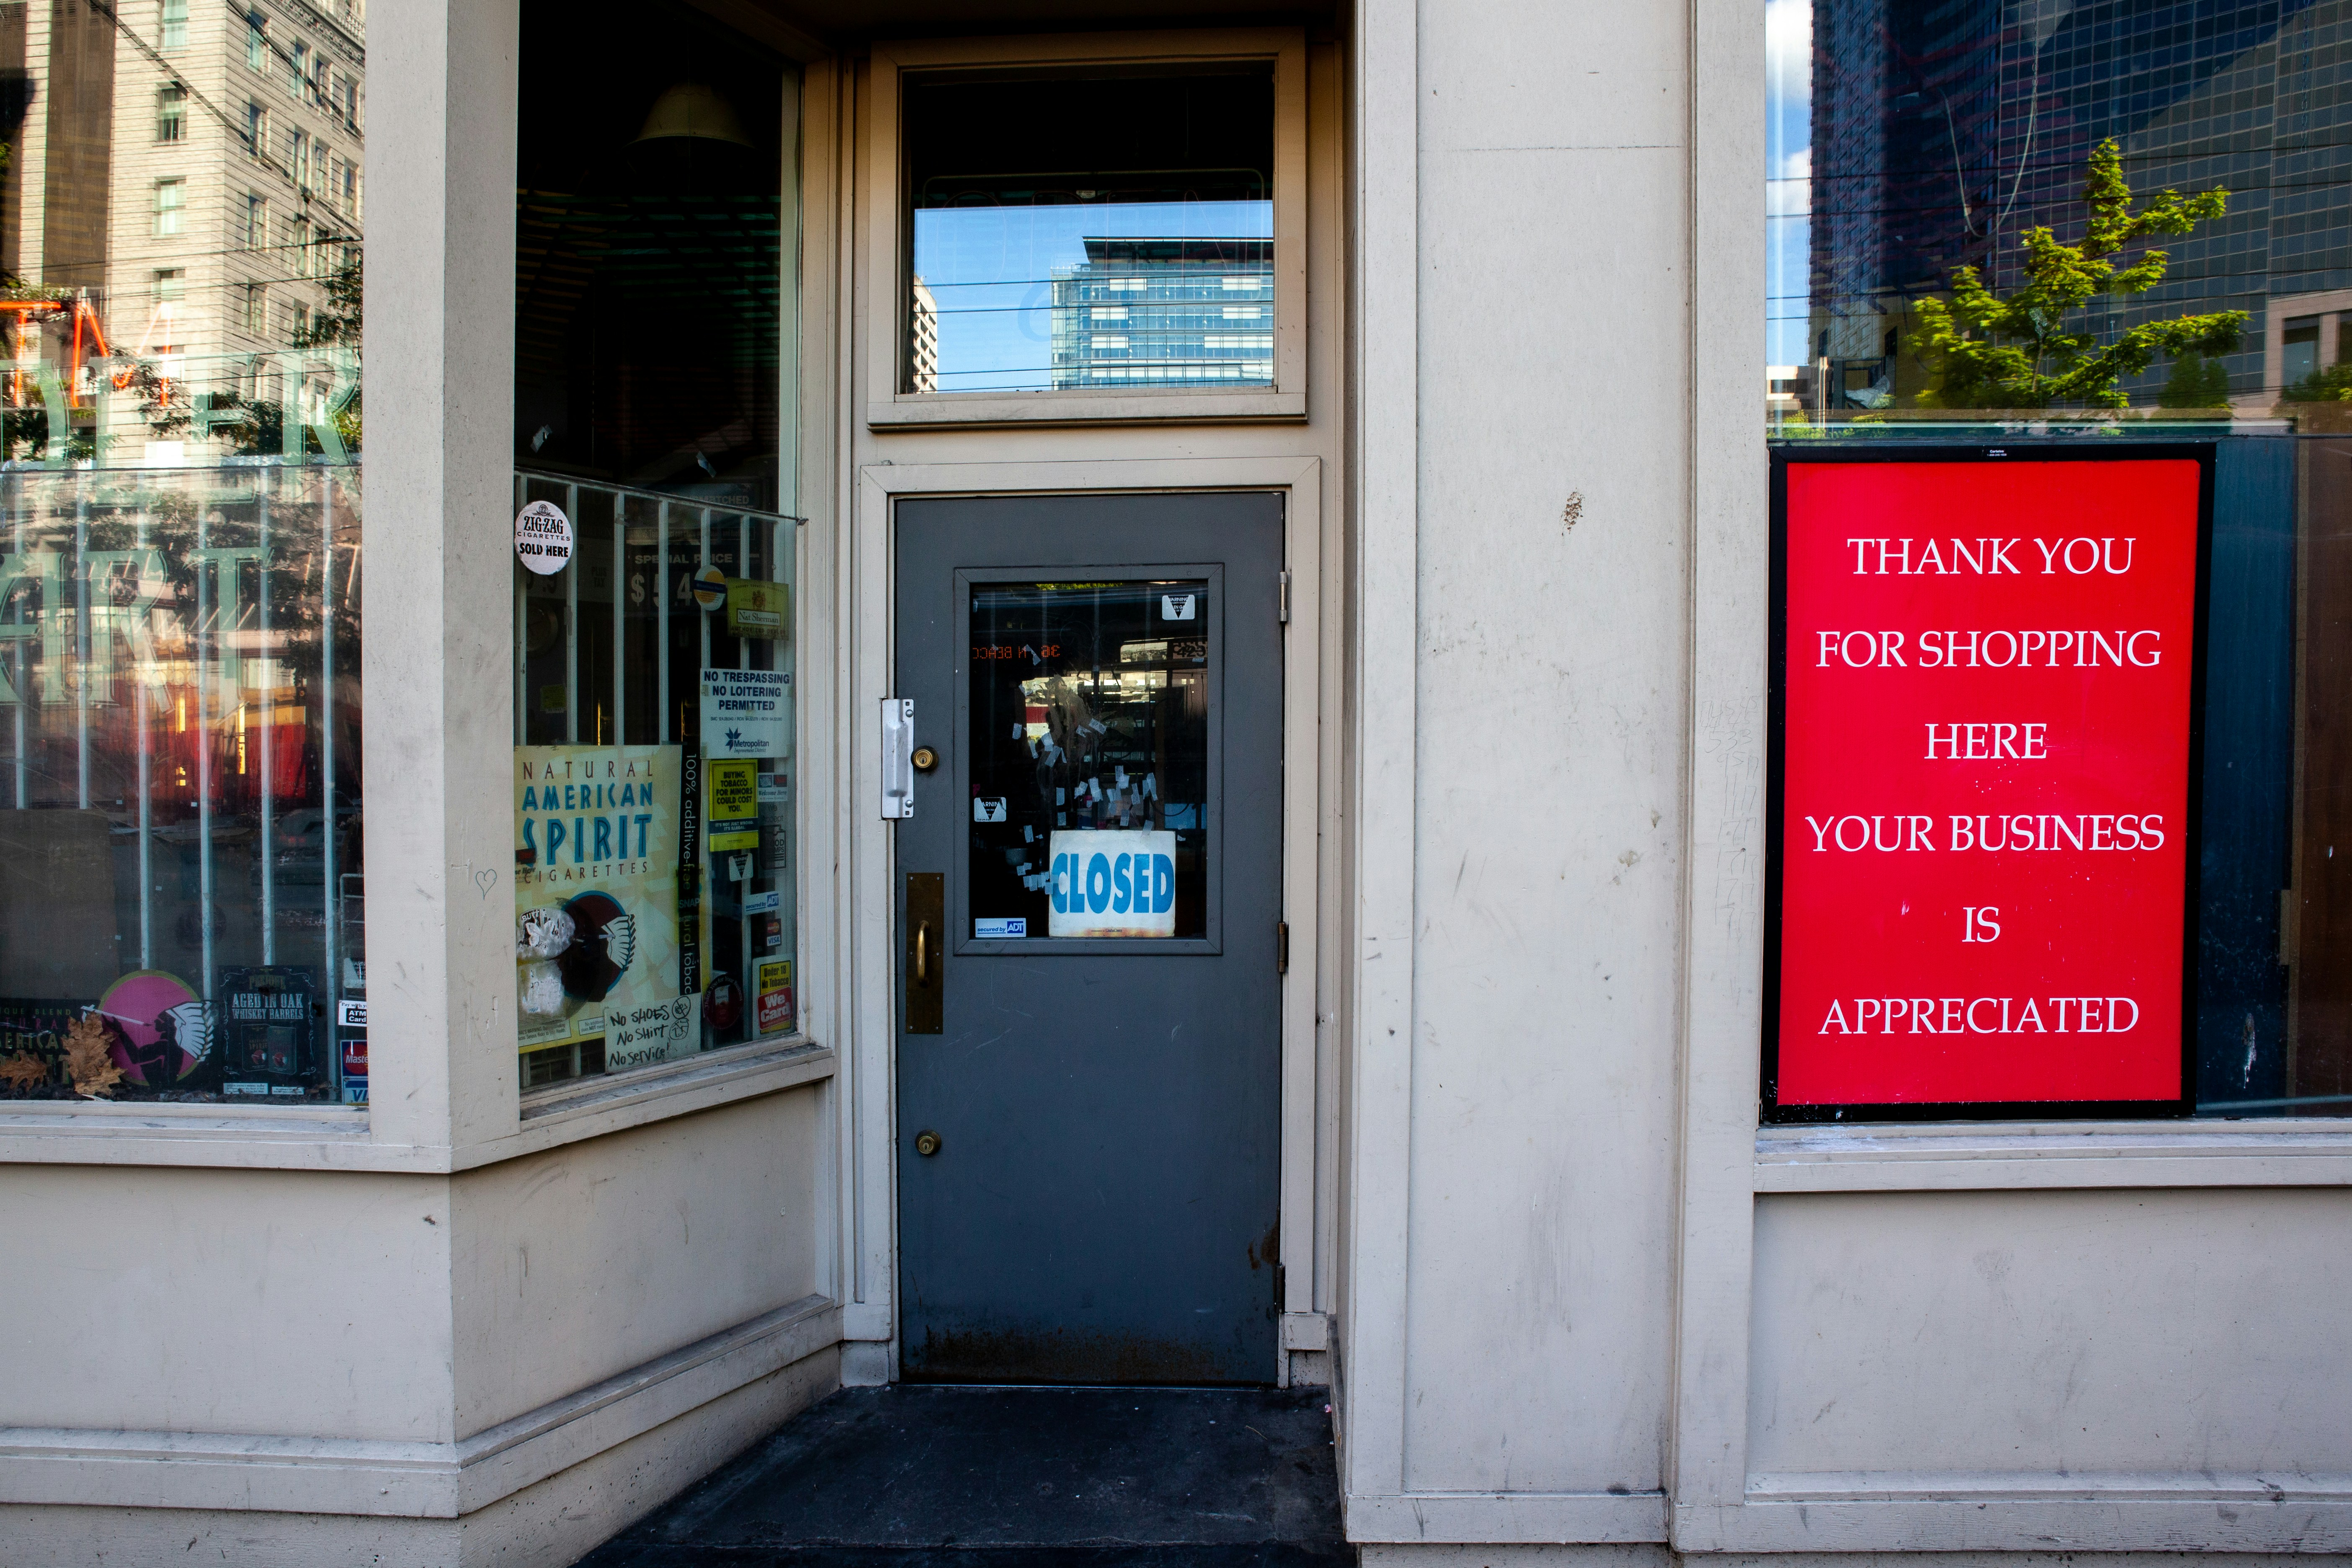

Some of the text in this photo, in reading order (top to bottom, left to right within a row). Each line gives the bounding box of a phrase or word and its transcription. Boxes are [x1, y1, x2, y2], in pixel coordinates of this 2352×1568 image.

[517, 531, 570, 541] CIGARETTES
[519, 543, 543, 556] SOLD
[546, 545, 569, 557] HERE
[1847, 537, 2137, 575] THANK YOU
[634, 553, 733, 565] SPEIAL PICE
[739, 611, 779, 624] Nat Sherman
[1816, 630, 2161, 668] FOR SHOPPING
[704, 671, 790, 684] NO TRESPASSING
[712, 685, 781, 697] NO LOITERING
[719, 700, 775, 711] PERMITTED
[734, 739, 769, 749] Metropolitan
[1924, 723, 2048, 760] HERE
[524, 759, 653, 780] NATURAL
[684, 753, 696, 794] 100%
[723, 771, 745, 779] BUYING
[522, 781, 653, 811] AMERICAN
[730, 787, 753, 795] MINORS
[523, 813, 652, 868] SPIRIT
[1805, 814, 2165, 852] YOUR BUSINESS
[524, 861, 647, 884] CIGARETTES
[1051, 852, 1175, 914] CLOSED
[678, 897, 700, 908] SNAP
[767, 895, 779, 905] ADT
[1007, 923, 1024, 932] ADT
[1961, 906, 2001, 943] IS
[768, 936, 780, 944] VISA
[764, 965, 786, 977] Under 18
[761, 977, 789, 989] No Tobacco
[232, 993, 303, 1008] AGED IN OAK
[764, 993, 785, 1008] We
[232, 1008, 304, 1019] WHISKEY BARRELS
[610, 1011, 627, 1026] No
[761, 1002, 791, 1023] Card
[1818, 997, 2140, 1034] APPRECIATED
[616, 1031, 634, 1046] No
[609, 1050, 627, 1067] No
